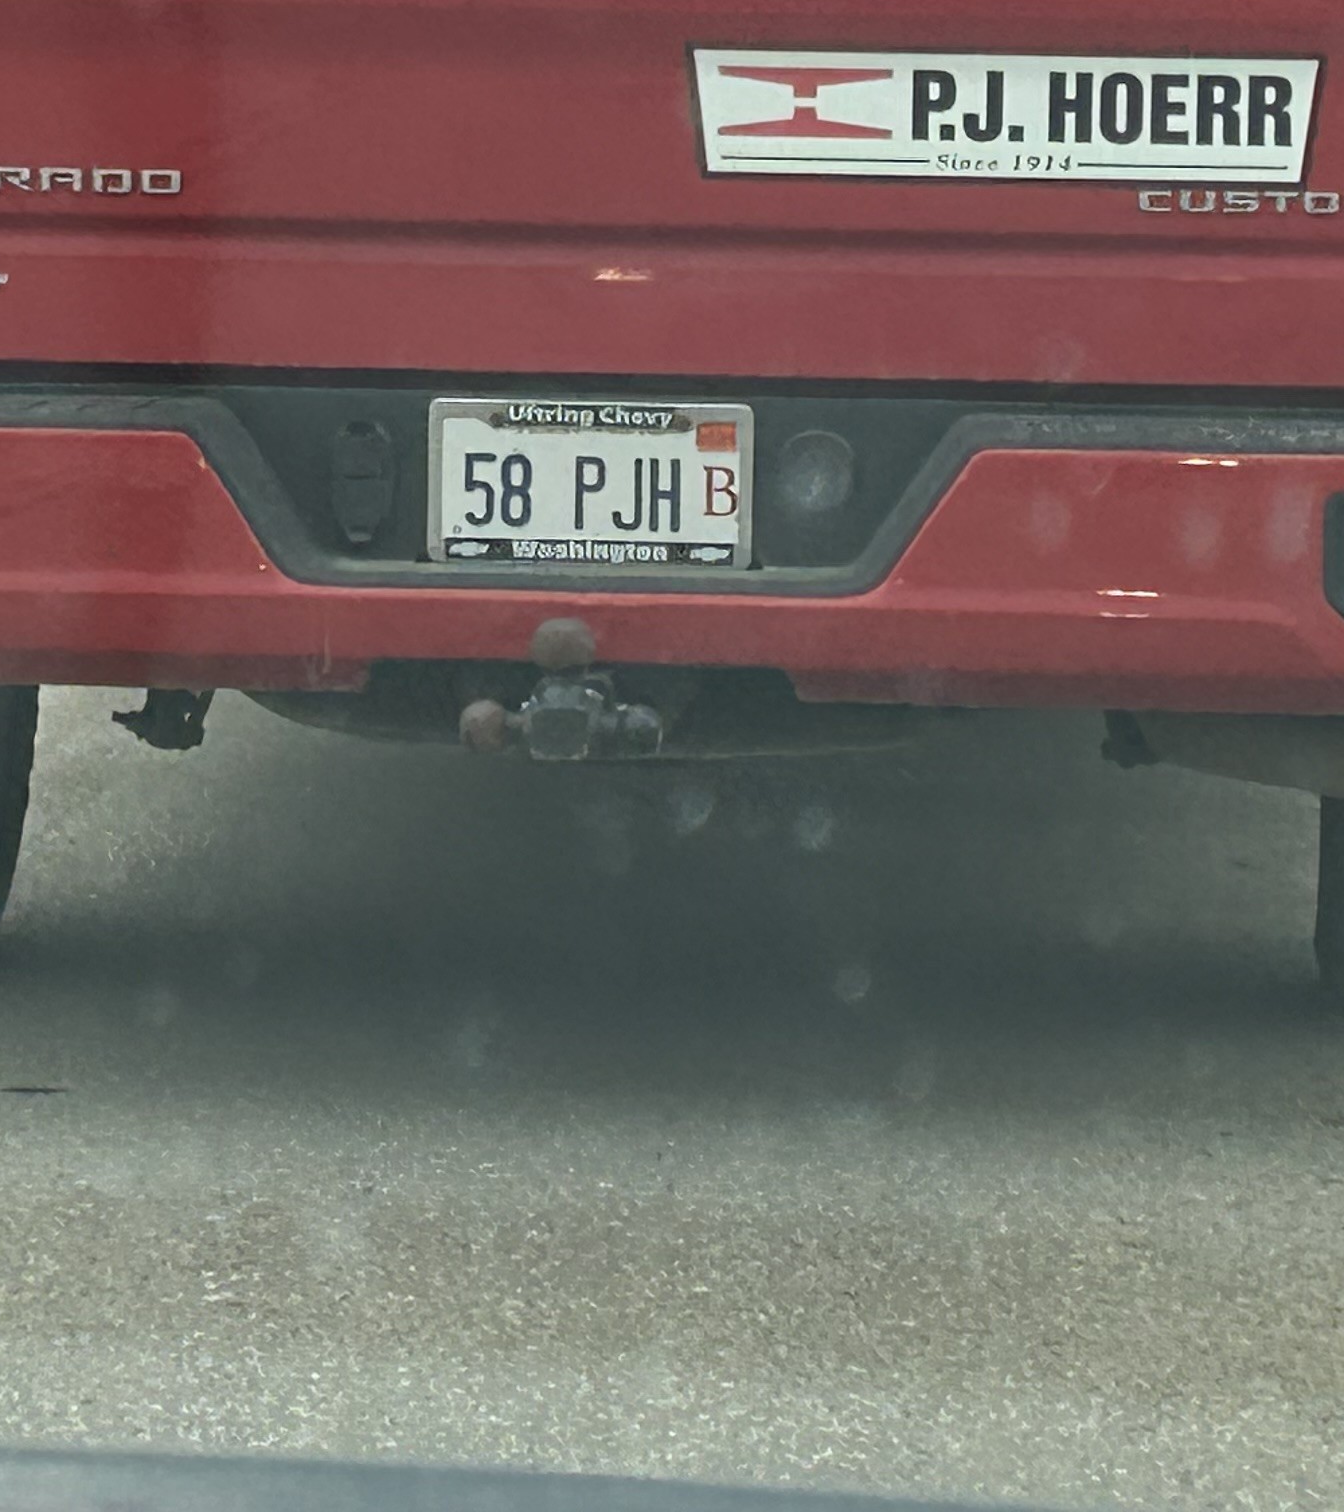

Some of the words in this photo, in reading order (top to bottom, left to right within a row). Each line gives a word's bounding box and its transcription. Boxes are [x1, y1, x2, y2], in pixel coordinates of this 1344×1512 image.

[911, 69, 1025, 144] P.J.
[1047, 71, 1293, 148] HOERR
[935, 153, 999, 171] Since
[1013, 154, 1072, 172] 1914
[599, 405, 673, 429] Chevy
[463, 452, 533, 527] 58
[573, 455, 681, 532] PJH
[702, 464, 738, 517] B
[512, 538, 668, 564] Washington
